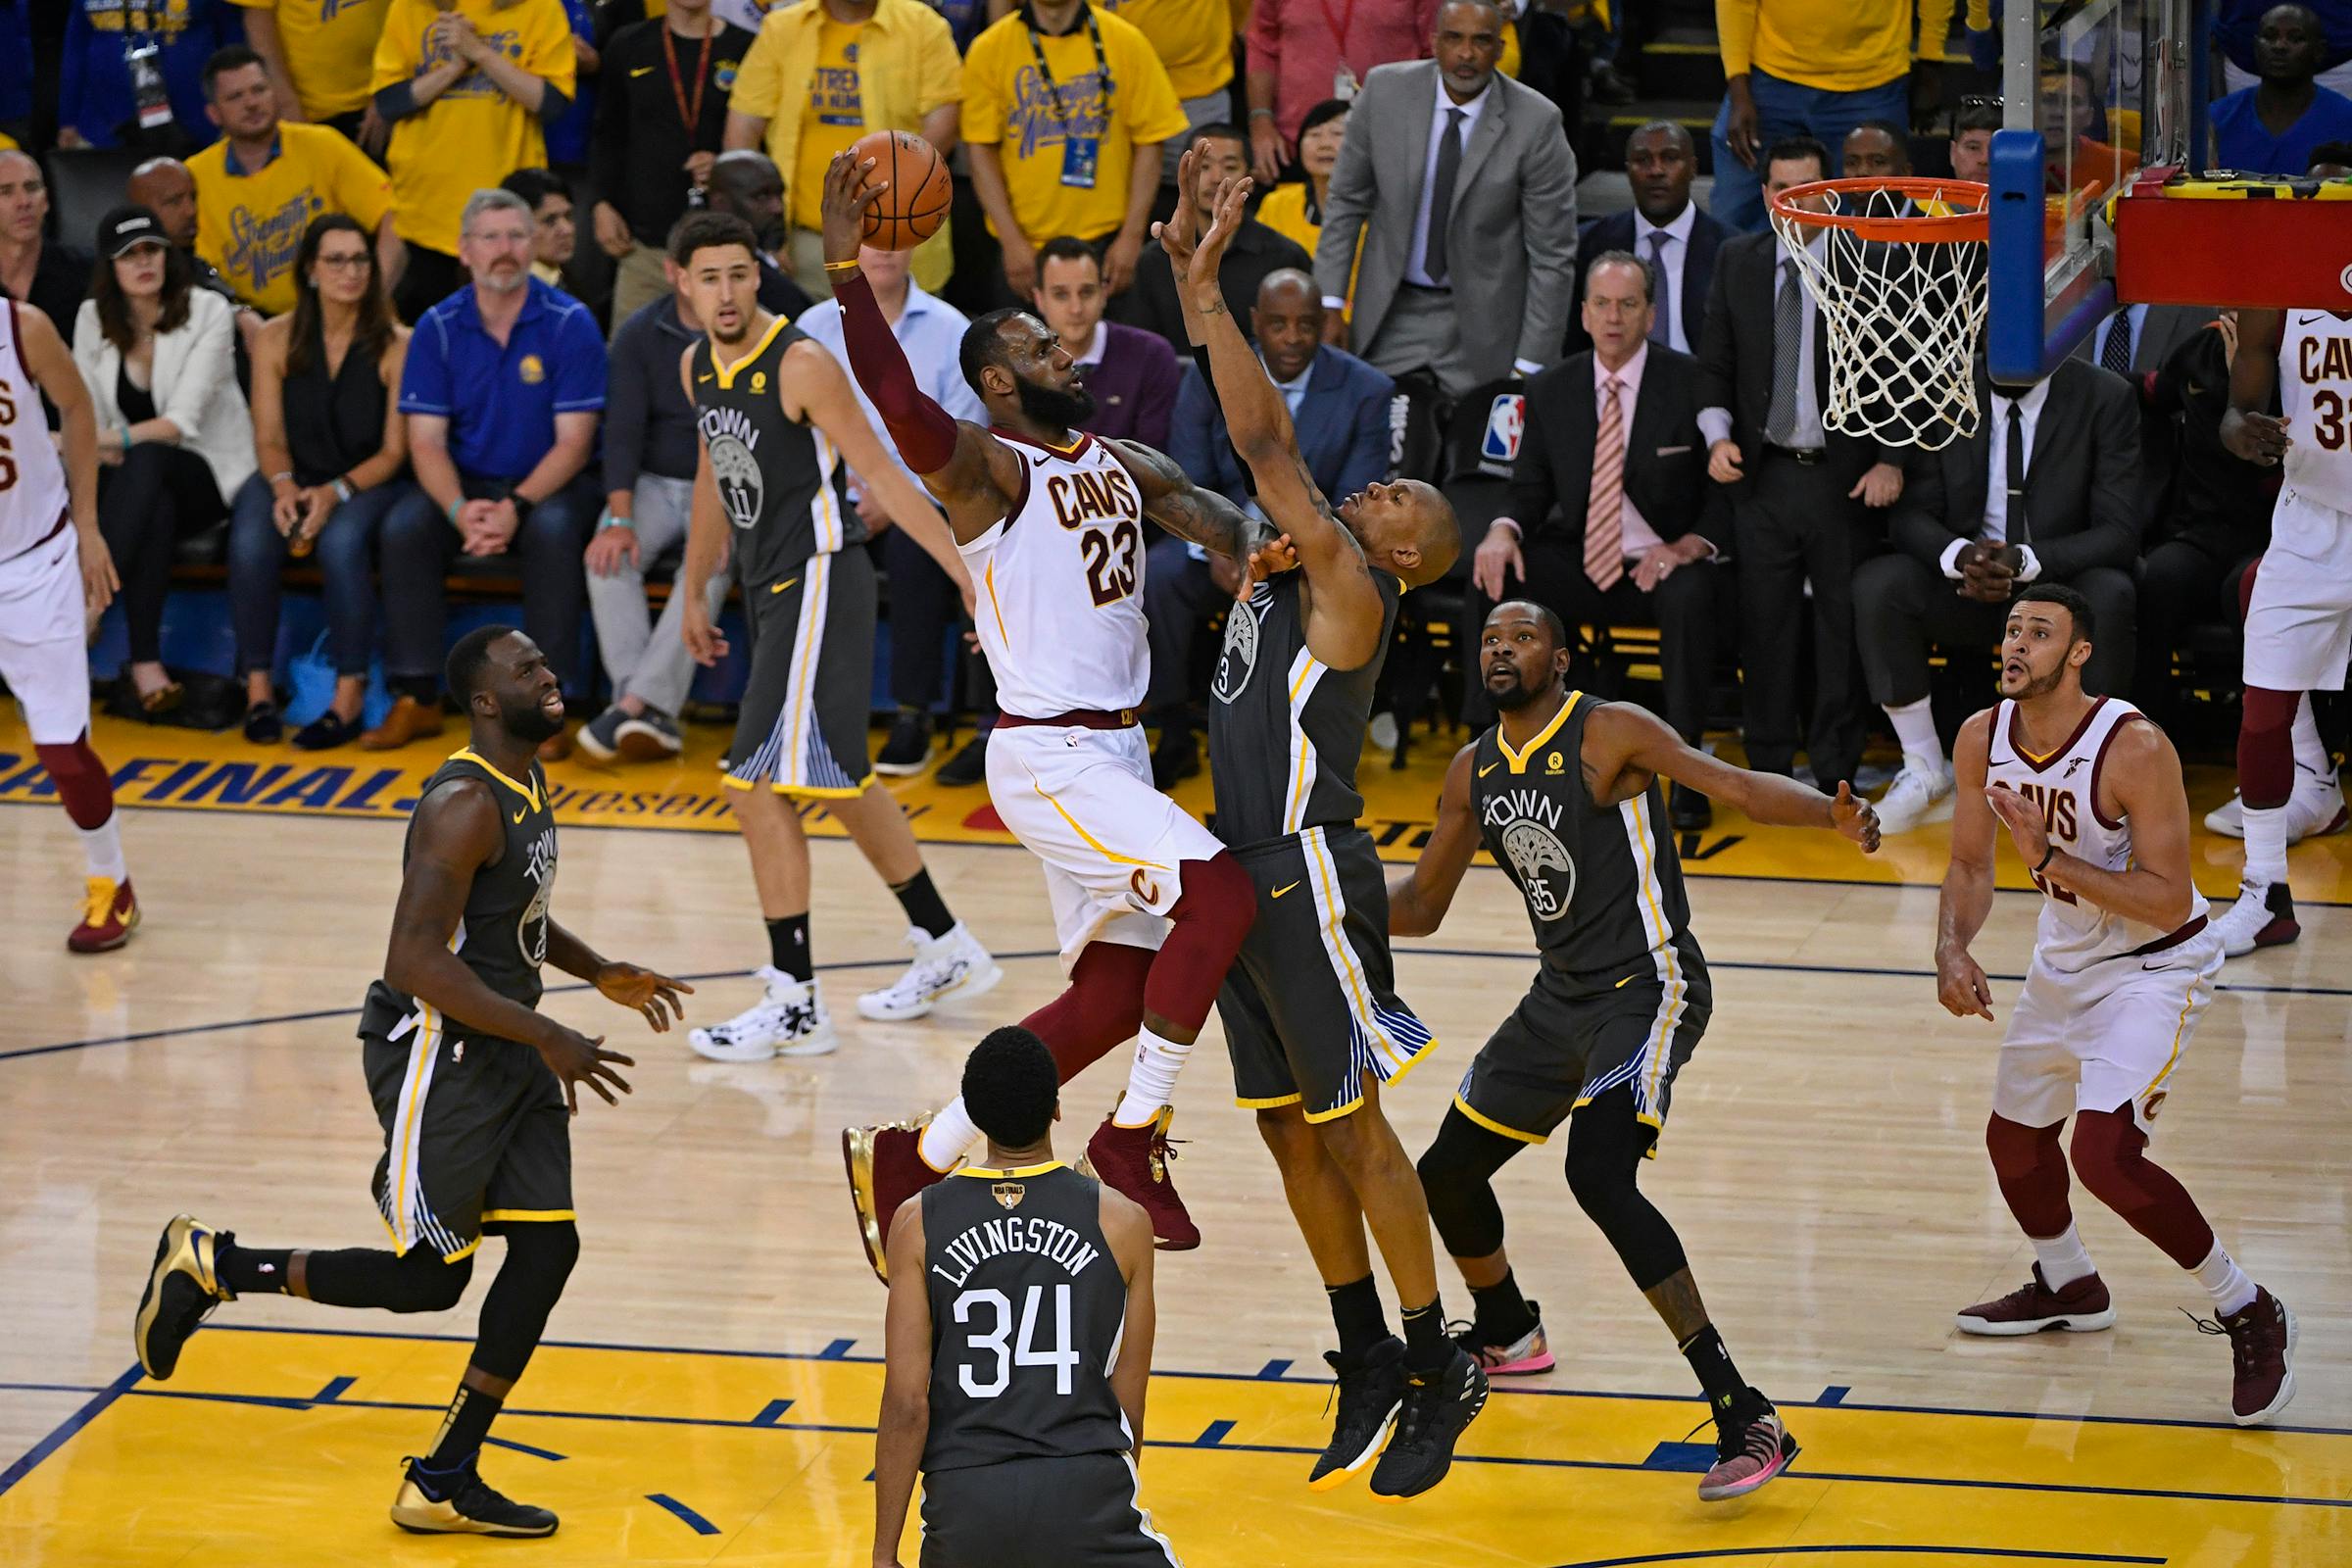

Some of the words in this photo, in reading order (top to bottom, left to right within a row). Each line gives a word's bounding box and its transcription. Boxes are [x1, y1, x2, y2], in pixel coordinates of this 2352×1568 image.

[2313, 389, 2352, 451] 3
[728, 487, 753, 521] 11
[1047, 468, 1139, 531] CAVS
[1081, 520, 1138, 609] 23
[110, 758, 433, 811] FINAL
[1484, 789, 1563, 831] TOWN
[1991, 780, 2079, 843] AVS
[1527, 878, 1558, 912] 35
[1005, 1186, 1023, 1195] FINALS
[932, 1217, 1100, 1288] LIVINGSTON
[953, 1284, 1080, 1397] 34
